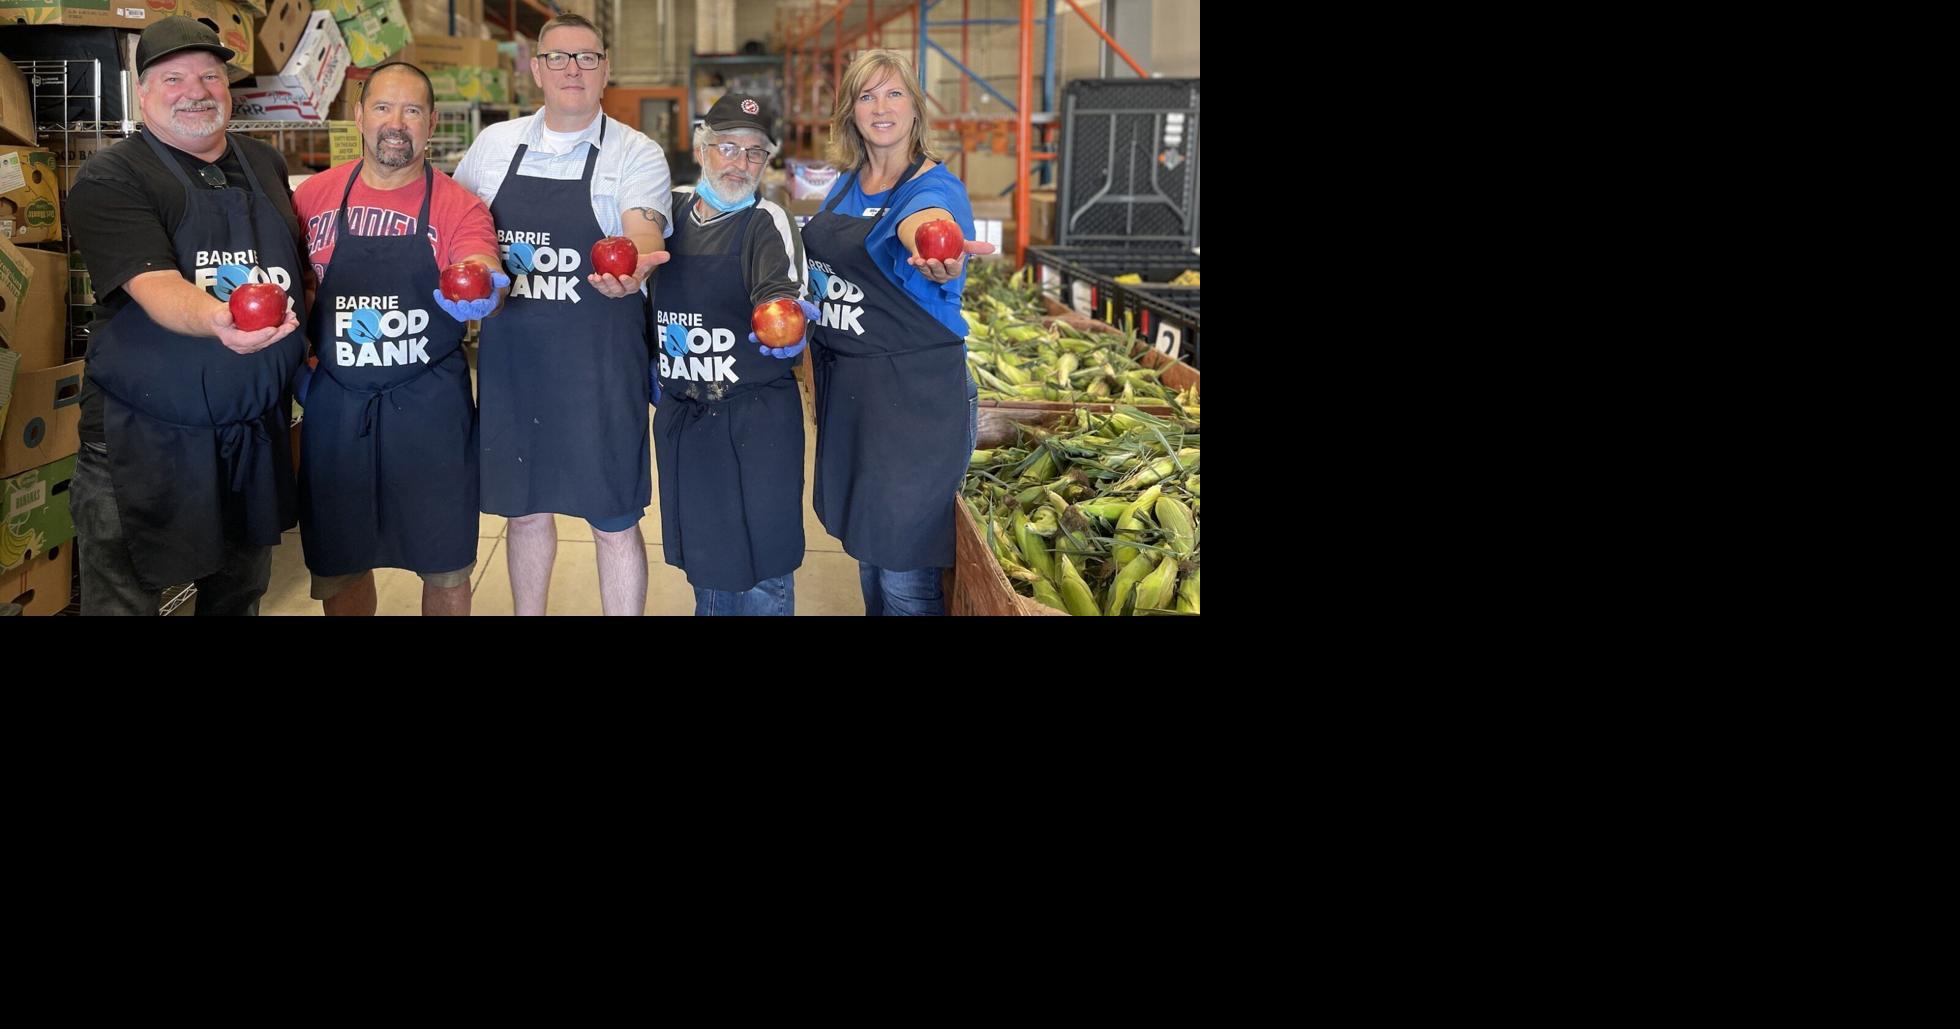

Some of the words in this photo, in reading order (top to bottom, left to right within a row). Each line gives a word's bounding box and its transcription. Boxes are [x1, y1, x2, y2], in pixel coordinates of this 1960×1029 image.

[497, 229, 551, 246] BARRIE
[195, 249, 259, 267] BARRI
[808, 258, 836, 275] RRIE
[509, 274, 582, 304] ANK
[335, 295, 399, 310] BARRIE
[335, 308, 430, 343] FOOD
[657, 309, 703, 327] BARRIE
[335, 335, 431, 367] BANK
[657, 324, 736, 356] FOOD
[659, 352, 740, 384] BANK
